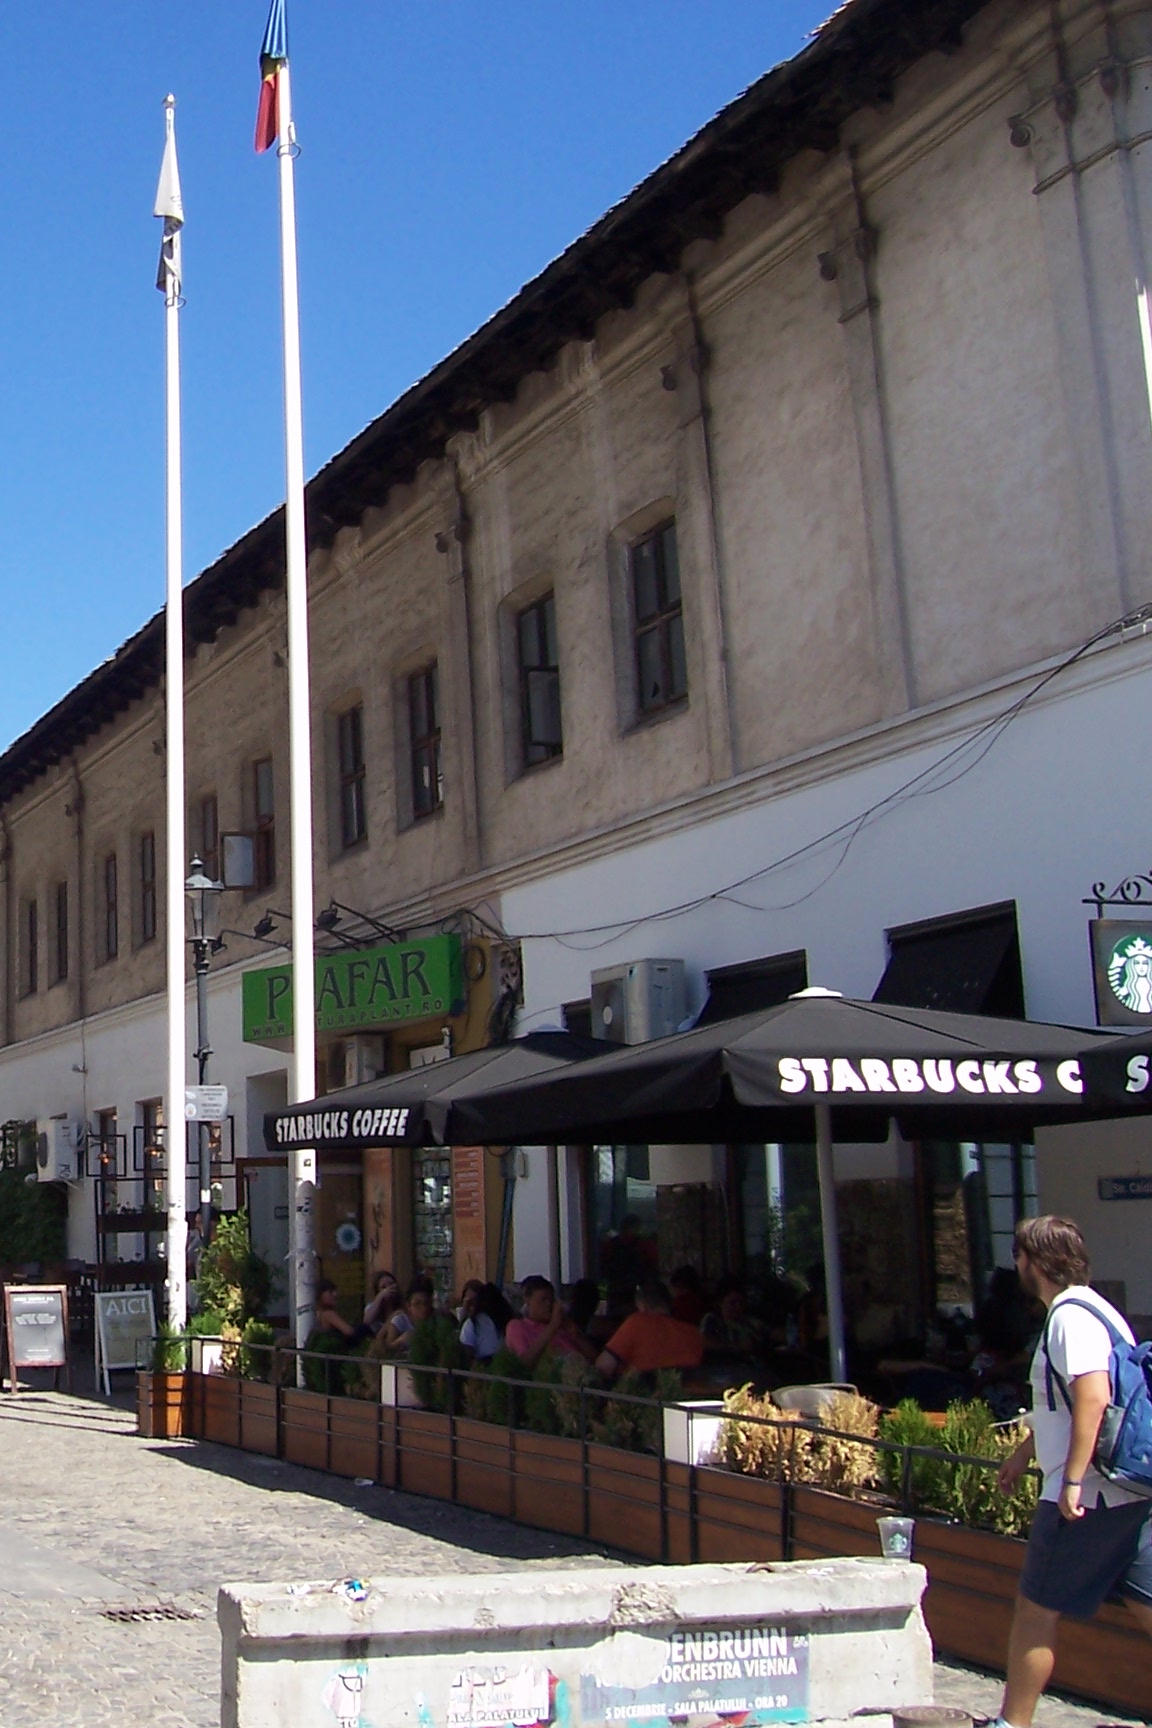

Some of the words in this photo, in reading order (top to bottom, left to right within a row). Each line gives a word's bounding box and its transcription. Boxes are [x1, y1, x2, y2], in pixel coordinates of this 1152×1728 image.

[266, 950, 432, 1021] PAFAR
[251, 999, 443, 1035] WWWTURAPLANT.RO
[778, 1057, 1042, 1094] STARBUCKS
[275, 1110, 349, 1144] STARBUCKS
[351, 1108, 410, 1137] COFFEE
[106, 1297, 148, 1316] AICI
[665, 1627, 788, 1664] ENBRUNN
[661, 1660, 742, 1684] ORCHESTRA
[743, 1656, 798, 1678] VIENNA
[476, 1706, 546, 1722] PALATULUI
[605, 1706, 612, 1719] 5
[613, 1702, 667, 1719] DECEMBRIE
[674, 1700, 698, 1715] SALA
[698, 1697, 747, 1713] PALATULUI
[754, 1696, 775, 1709] ORA
[776, 1694, 788, 1708] 20
